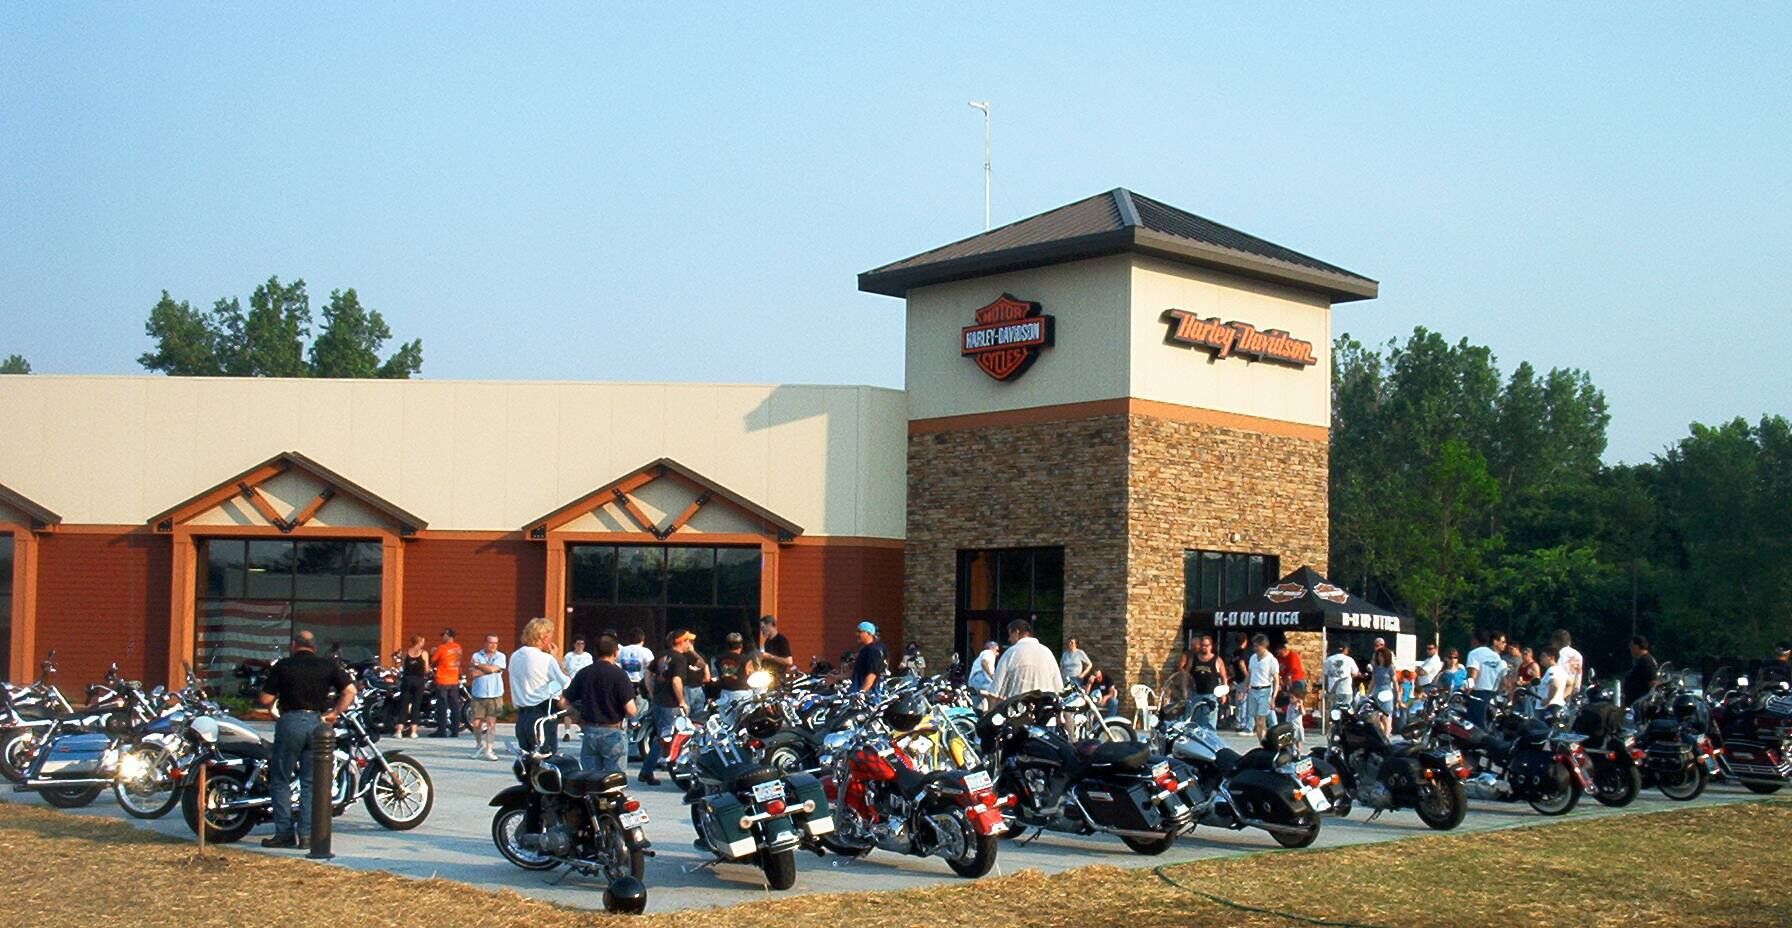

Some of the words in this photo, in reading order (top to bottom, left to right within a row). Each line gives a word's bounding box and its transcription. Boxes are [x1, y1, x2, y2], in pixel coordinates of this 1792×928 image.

[982, 305, 1022, 322] MOTOR
[966, 322, 1040, 349] HARLEY-DAVIDSON
[981, 349, 1021, 370] CYCLES
[1259, 611, 1300, 625] UTICA
